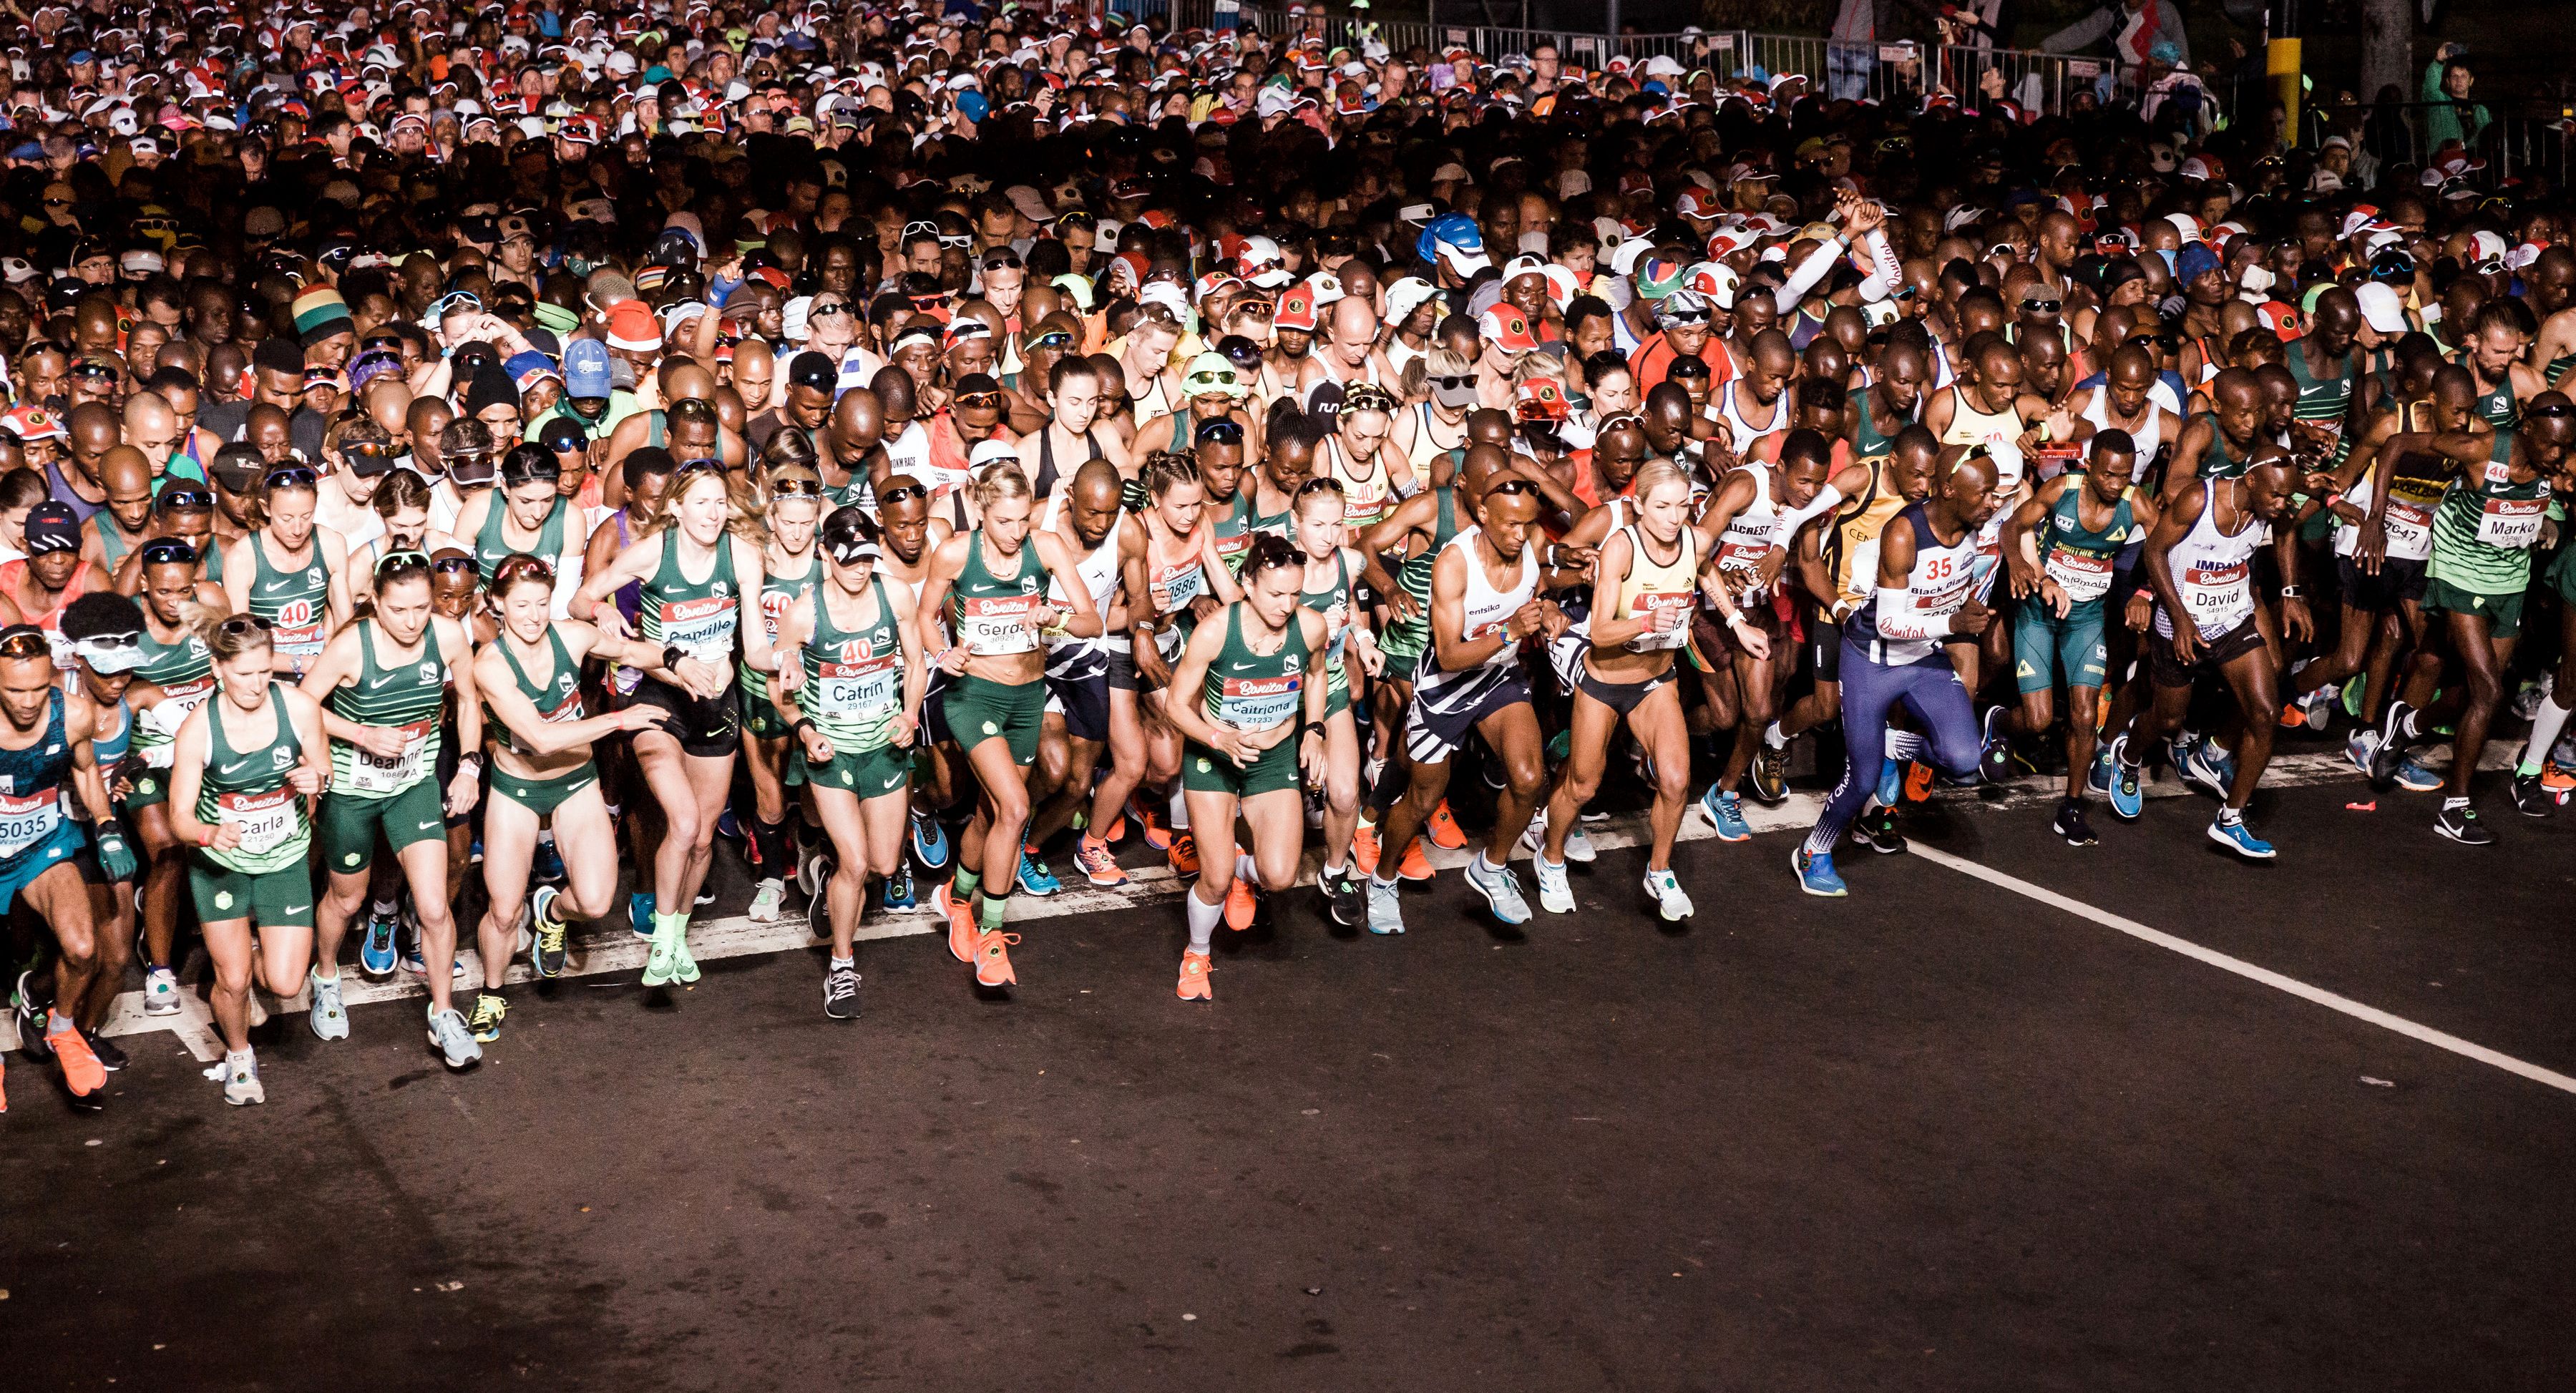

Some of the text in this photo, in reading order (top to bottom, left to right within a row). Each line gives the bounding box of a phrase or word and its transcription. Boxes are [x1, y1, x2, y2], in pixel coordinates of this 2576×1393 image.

[1318, 402, 1340, 413] run
[904, 457, 916, 467] RACE
[2489, 466, 2508, 479] 40
[1357, 484, 1374, 503] 40
[1344, 504, 1381, 517] Bonitas
[2499, 502, 2541, 514] Bonitas
[2491, 521, 2535, 534] Marko
[1163, 559, 1196, 580] Bonitas
[1926, 557, 1952, 580] 35
[2062, 554, 2104, 572] Bonitas
[2200, 570, 2240, 585] Bonitas
[1911, 586, 1943, 595] Black
[2196, 588, 2239, 606] David
[1171, 592, 1190, 604] xandra
[1646, 595, 1689, 610] Bonitas
[281, 602, 308, 624] 40
[673, 601, 722, 620] Bonitas
[980, 600, 1029, 615] Bonitas
[1469, 604, 1501, 615] entsika
[2206, 606, 2228, 615] 54915
[1880, 617, 1928, 638] Bonitas
[1028, 638, 1035, 649] A
[1677, 638, 1684, 647] A
[843, 639, 871, 663] 40
[835, 662, 882, 677] Bonitas
[834, 682, 883, 702] Catrin
[1239, 681, 1289, 695] Bonitas
[848, 700, 872, 710] 29167
[1231, 702, 1290, 714] Caitriona
[360, 748, 421, 769] Deanne
[410, 768, 418, 777] A
[233, 793, 286, 811] Bonitas
[236, 816, 283, 834] Carla
[248, 833, 275, 842] 21250
